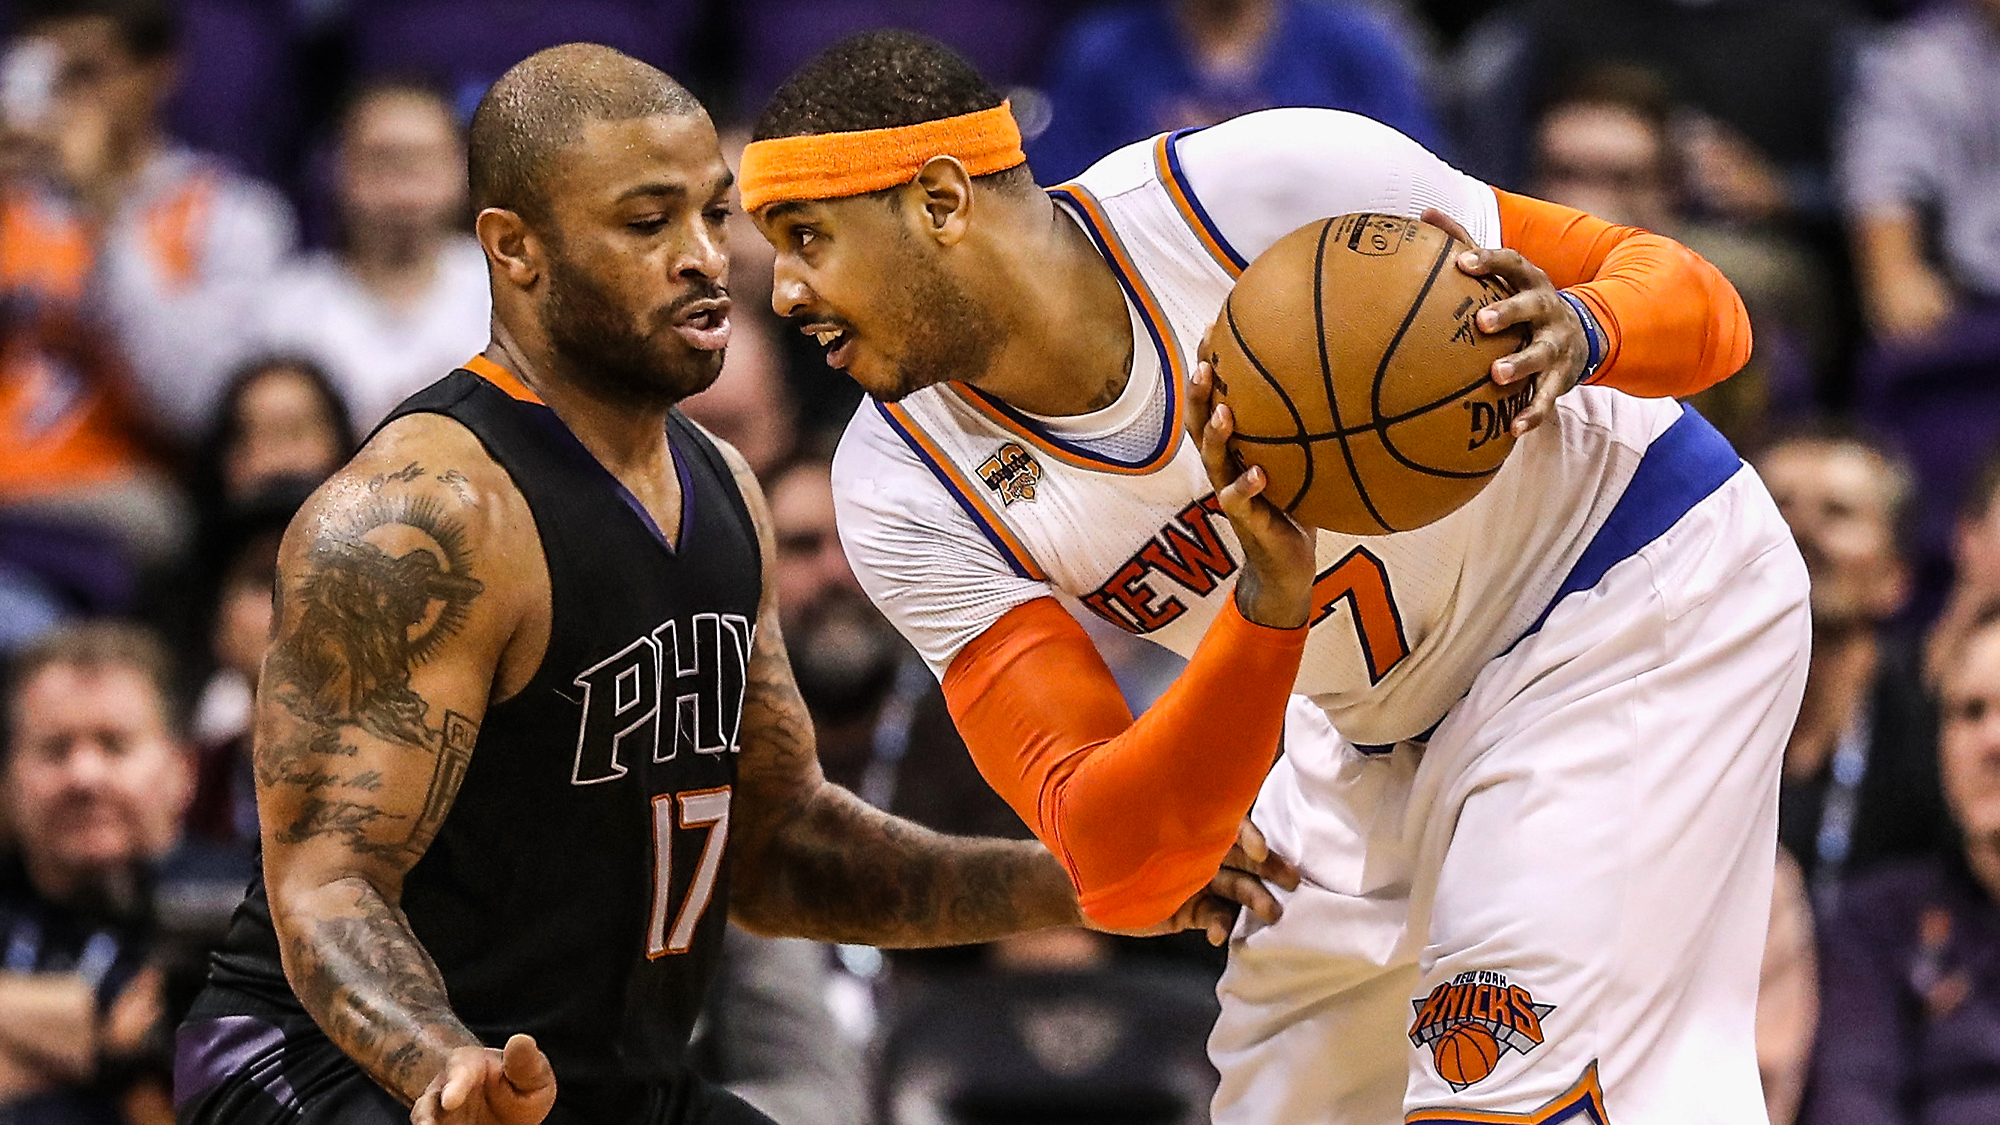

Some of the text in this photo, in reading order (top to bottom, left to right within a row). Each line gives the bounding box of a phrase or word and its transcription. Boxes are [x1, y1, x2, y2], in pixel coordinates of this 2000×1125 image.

[1077, 499, 1239, 635] NEW
[1308, 544, 1411, 687] 7
[645, 784, 732, 960] 17
[1408, 981, 1545, 1045] KNICKS
[1452, 970, 1507, 988] NEW YORK
